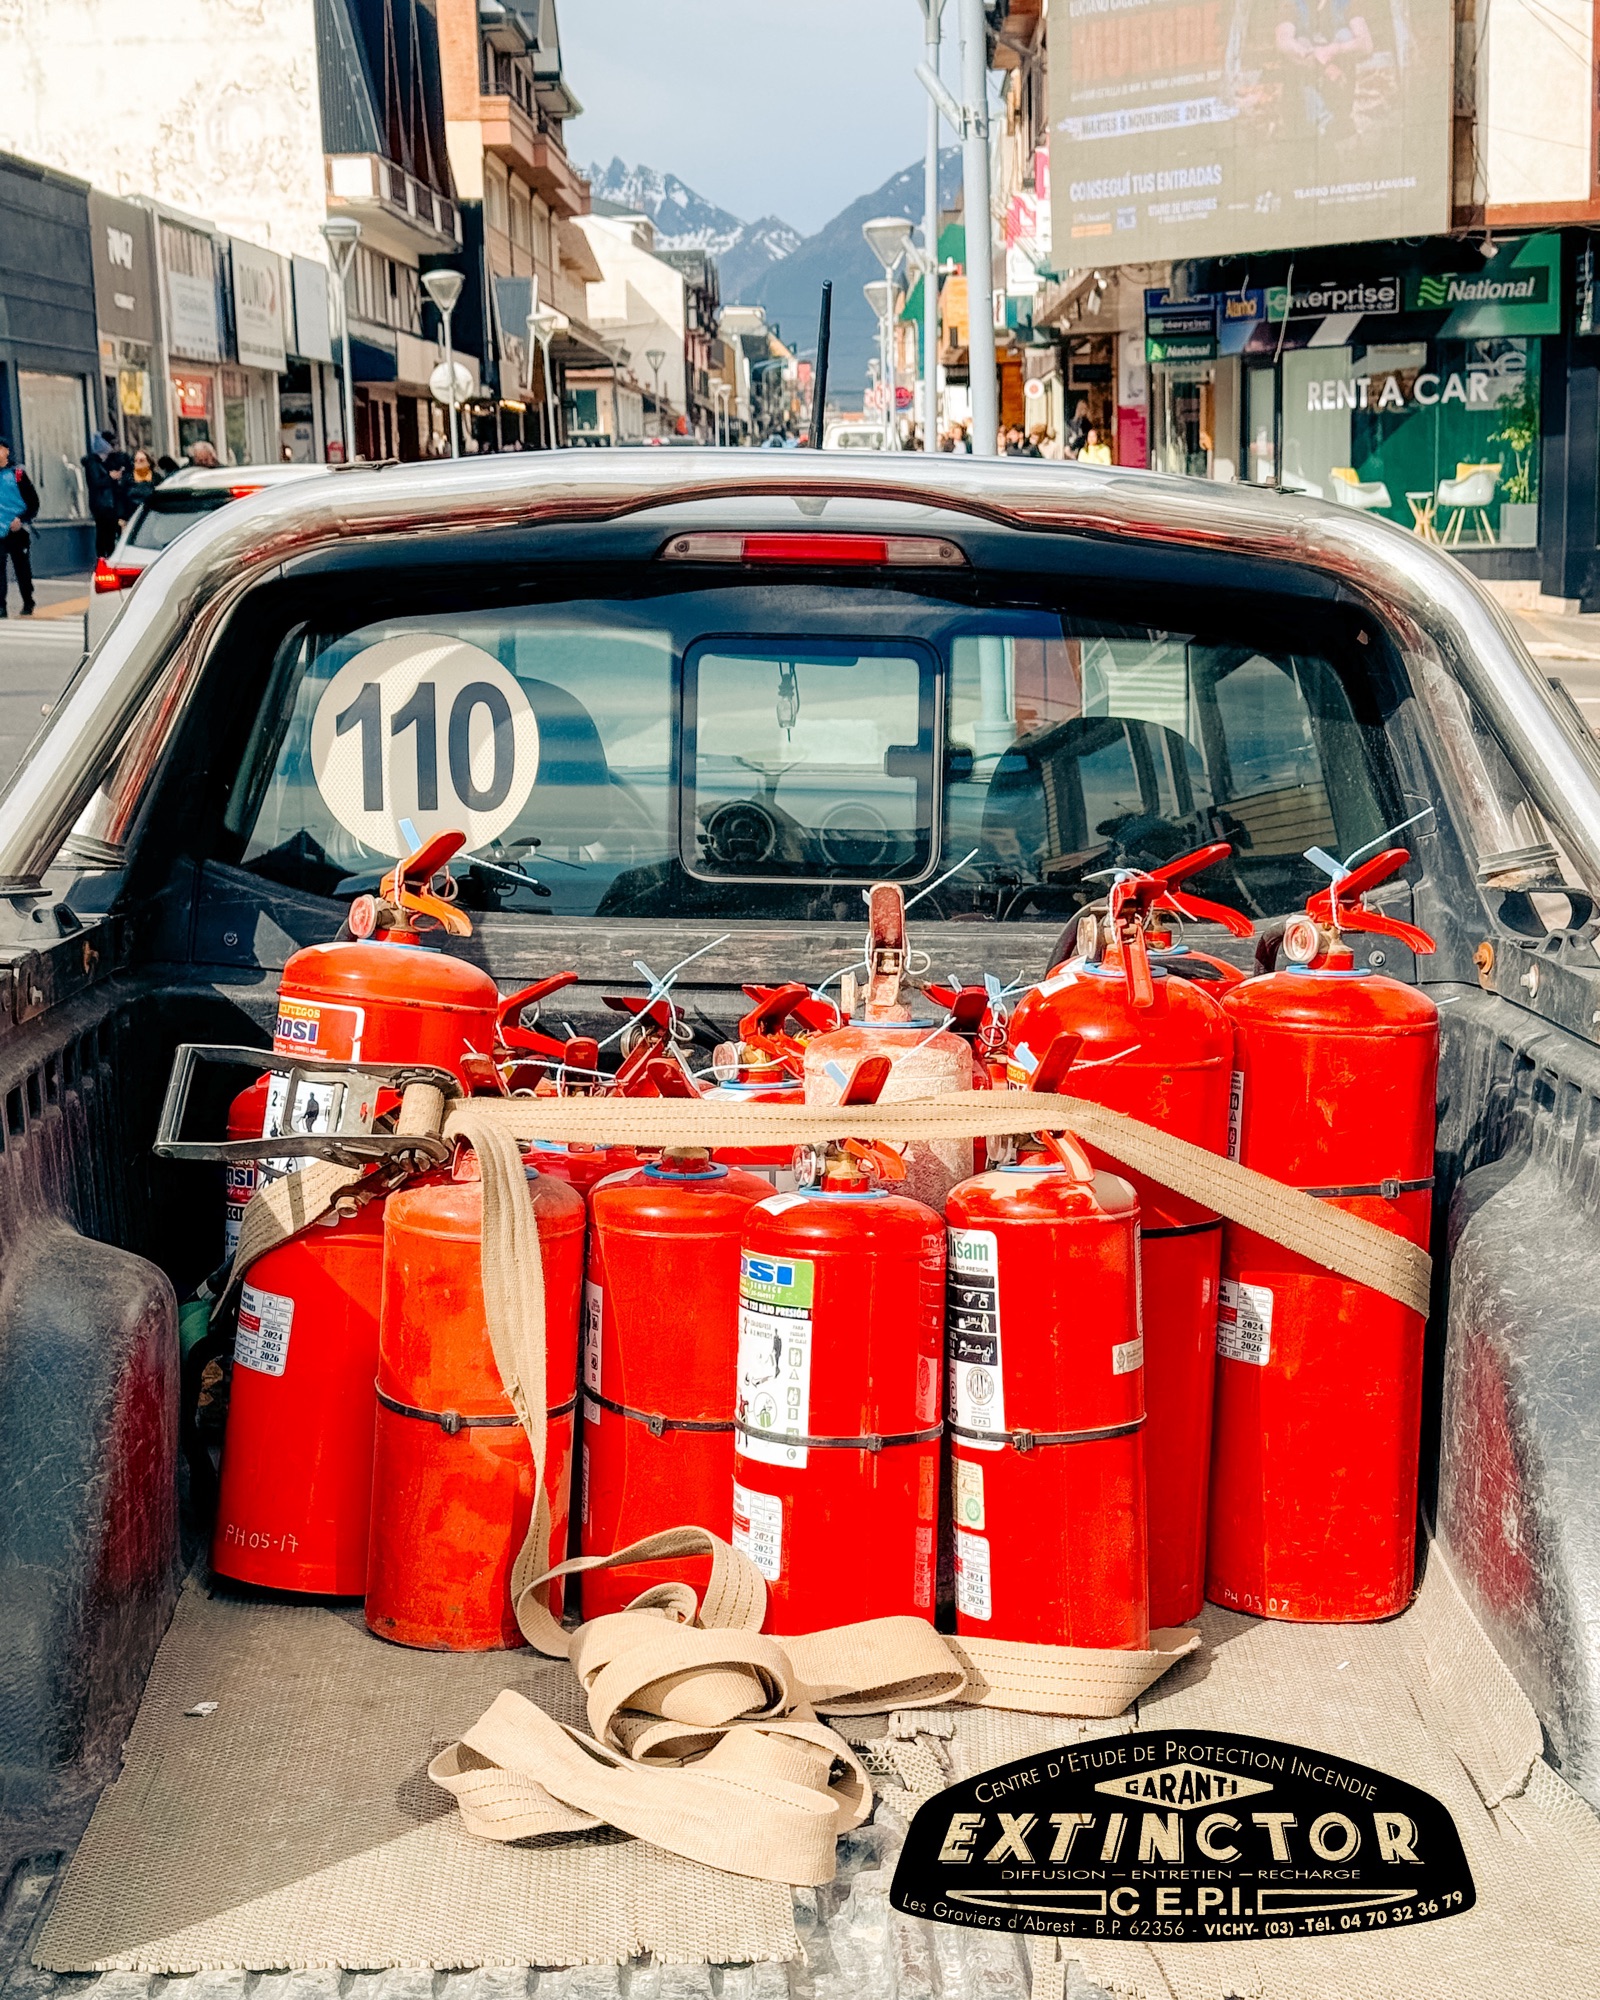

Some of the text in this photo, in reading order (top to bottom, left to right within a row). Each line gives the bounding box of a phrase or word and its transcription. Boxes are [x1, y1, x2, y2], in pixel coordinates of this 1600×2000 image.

[1128, 108, 1181, 130] NOVIEMBRE
[1069, 163, 1223, 202] CONSEGUÍ TUS ENTRADAS
[1447, 276, 1536, 302] National
[1307, 371, 1490, 412] RENT A CAR
[335, 681, 516, 813] 110
[775, 1307, 809, 1320] PRESIÓN
[1242, 1319, 1264, 1332] 2024
[263, 1329, 283, 1341] 2024
[1241, 1330, 1263, 1342] 2025
[261, 1341, 281, 1352] 2025
[1240, 1341, 1262, 1353] 2026
[260, 1351, 280, 1363] 2026
[225, 1524, 299, 1553] PH 05-17
[754, 1531, 774, 1543] 2024
[753, 1543, 774, 1555] 2025
[753, 1554, 773, 1567] 2026
[966, 1570, 984, 1583] 2024
[966, 1581, 984, 1595] 2025
[967, 1593, 985, 1606] 2026
